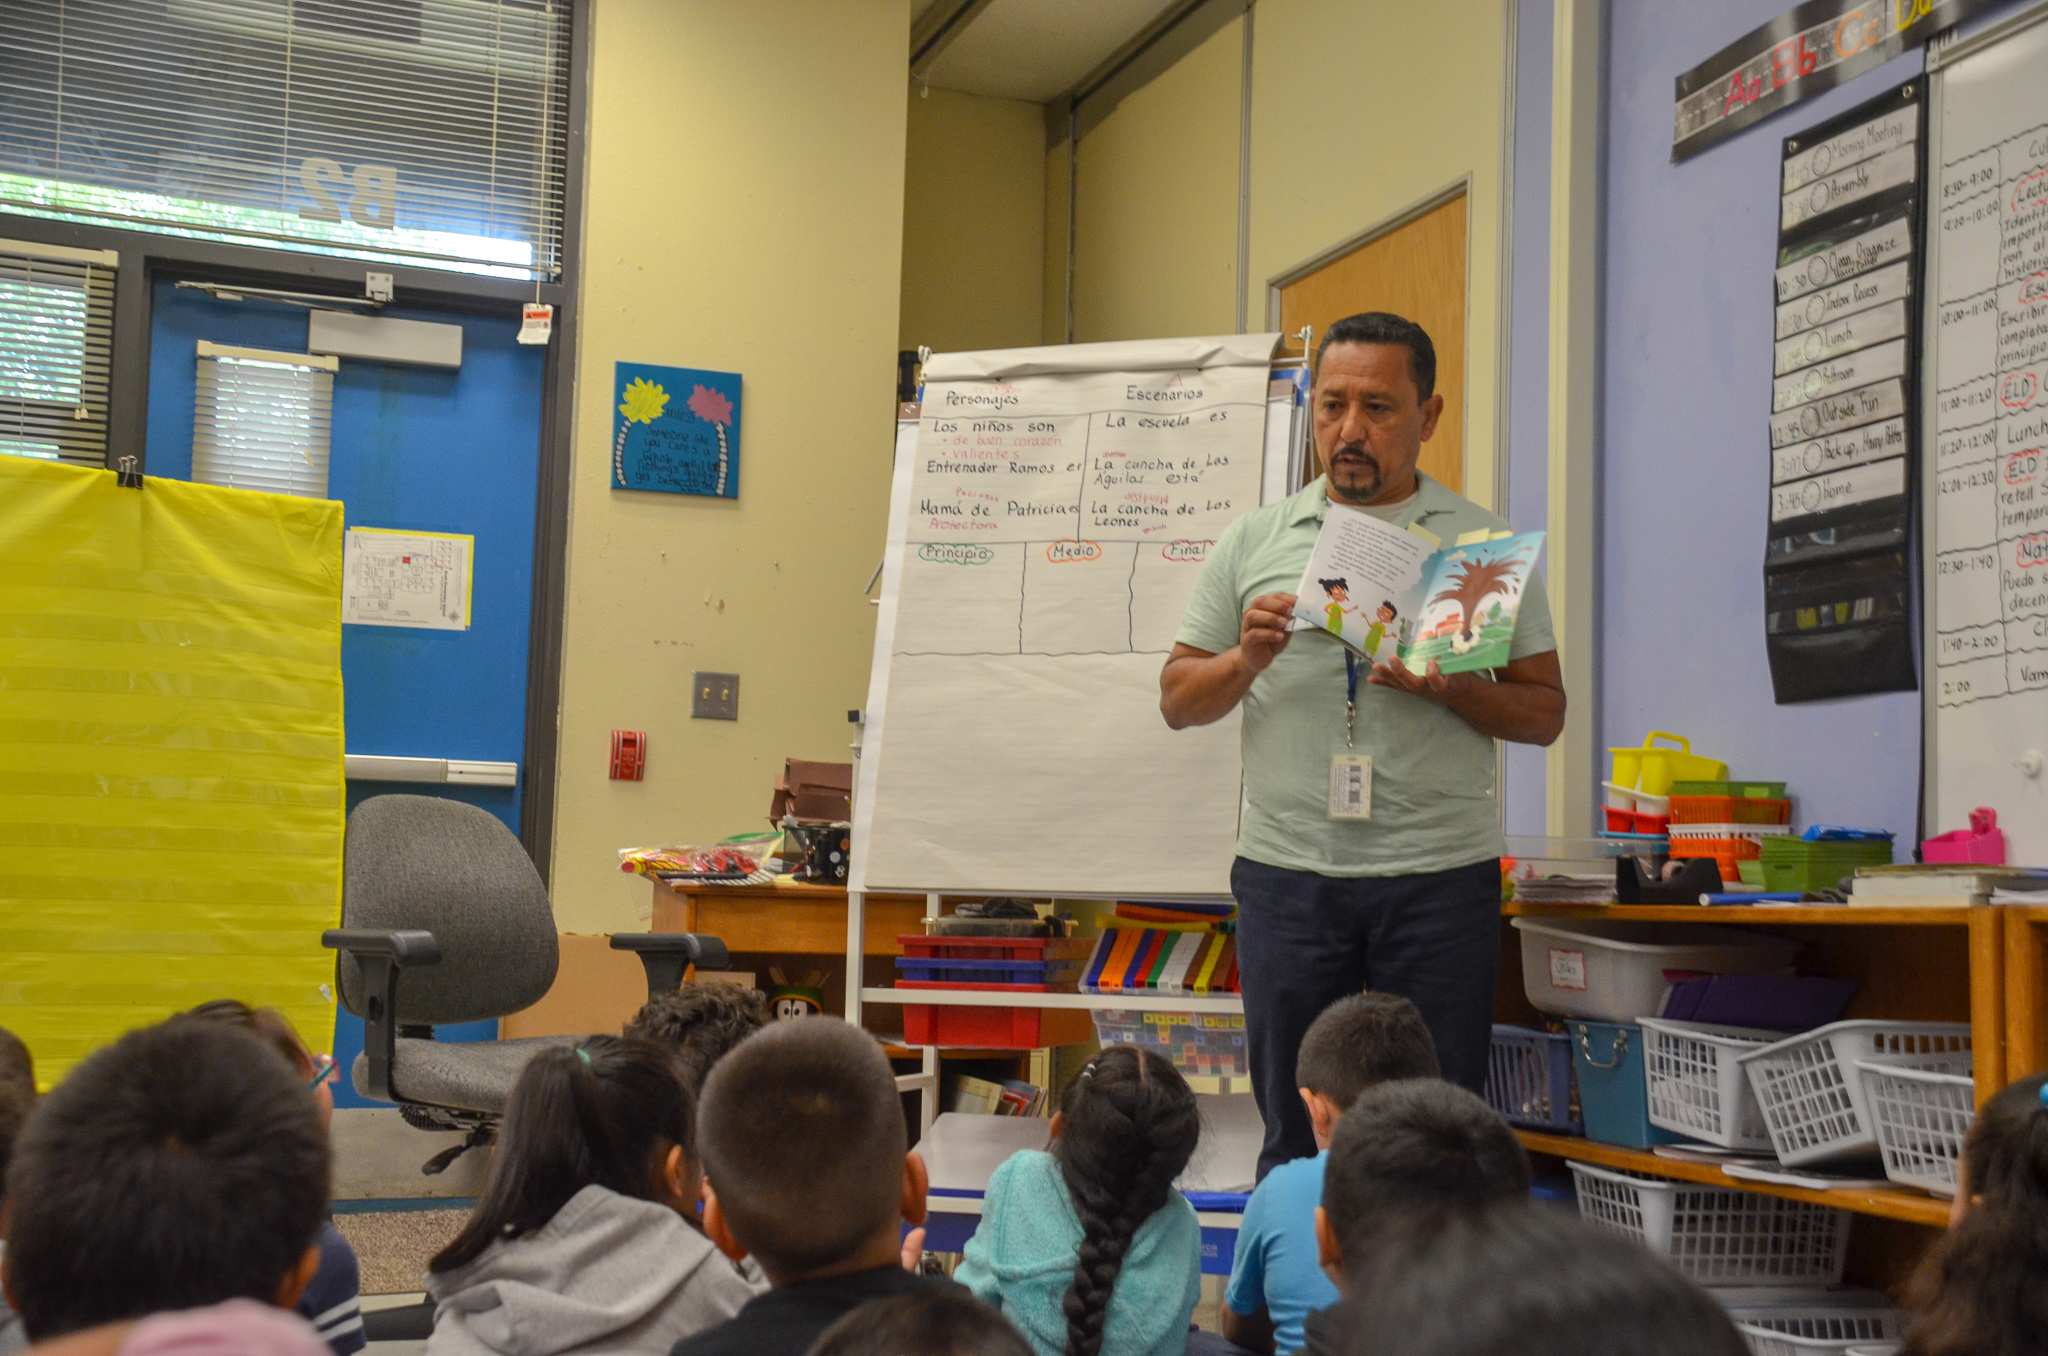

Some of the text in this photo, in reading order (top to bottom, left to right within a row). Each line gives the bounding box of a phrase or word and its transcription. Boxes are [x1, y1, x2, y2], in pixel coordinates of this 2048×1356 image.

[1722, 71, 1760, 118] Aa
[1773, 35, 1816, 89] Bb
[1835, 11, 1879, 58] Cc
[1867, 120, 1903, 146] Meeting
[1824, 321, 1852, 348] Lunch
[1126, 385, 1204, 401] Escenarios
[2005, 377, 2030, 400] ELD
[946, 390, 1019, 410] Personajes
[1857, 391, 1880, 413] Fun
[933, 419, 1056, 433] Los niños son
[1105, 411, 1228, 429] La escuela es
[953, 434, 968, 446] de
[926, 460, 998, 474] Entrenador
[1009, 461, 1056, 474] Ramos
[1094, 457, 1113, 470] La
[1125, 458, 1174, 471] cancha
[1182, 456, 1196, 469] de
[2009, 457, 2037, 479] ELD
[2001, 485, 2034, 504] retell
[920, 498, 963, 515] Mamá
[970, 503, 991, 516] de
[1007, 500, 1067, 516] Patricia
[1091, 500, 1108, 514] La
[1117, 502, 1169, 516] cancha
[1177, 503, 1196, 515] de
[1094, 516, 1140, 527] Leones
[926, 545, 988, 566] Principio
[1053, 545, 1095, 558] Medio
[1170, 543, 1206, 556] Final
[2003, 570, 2034, 592] Puedo
[1943, 680, 1971, 694] 2:00
